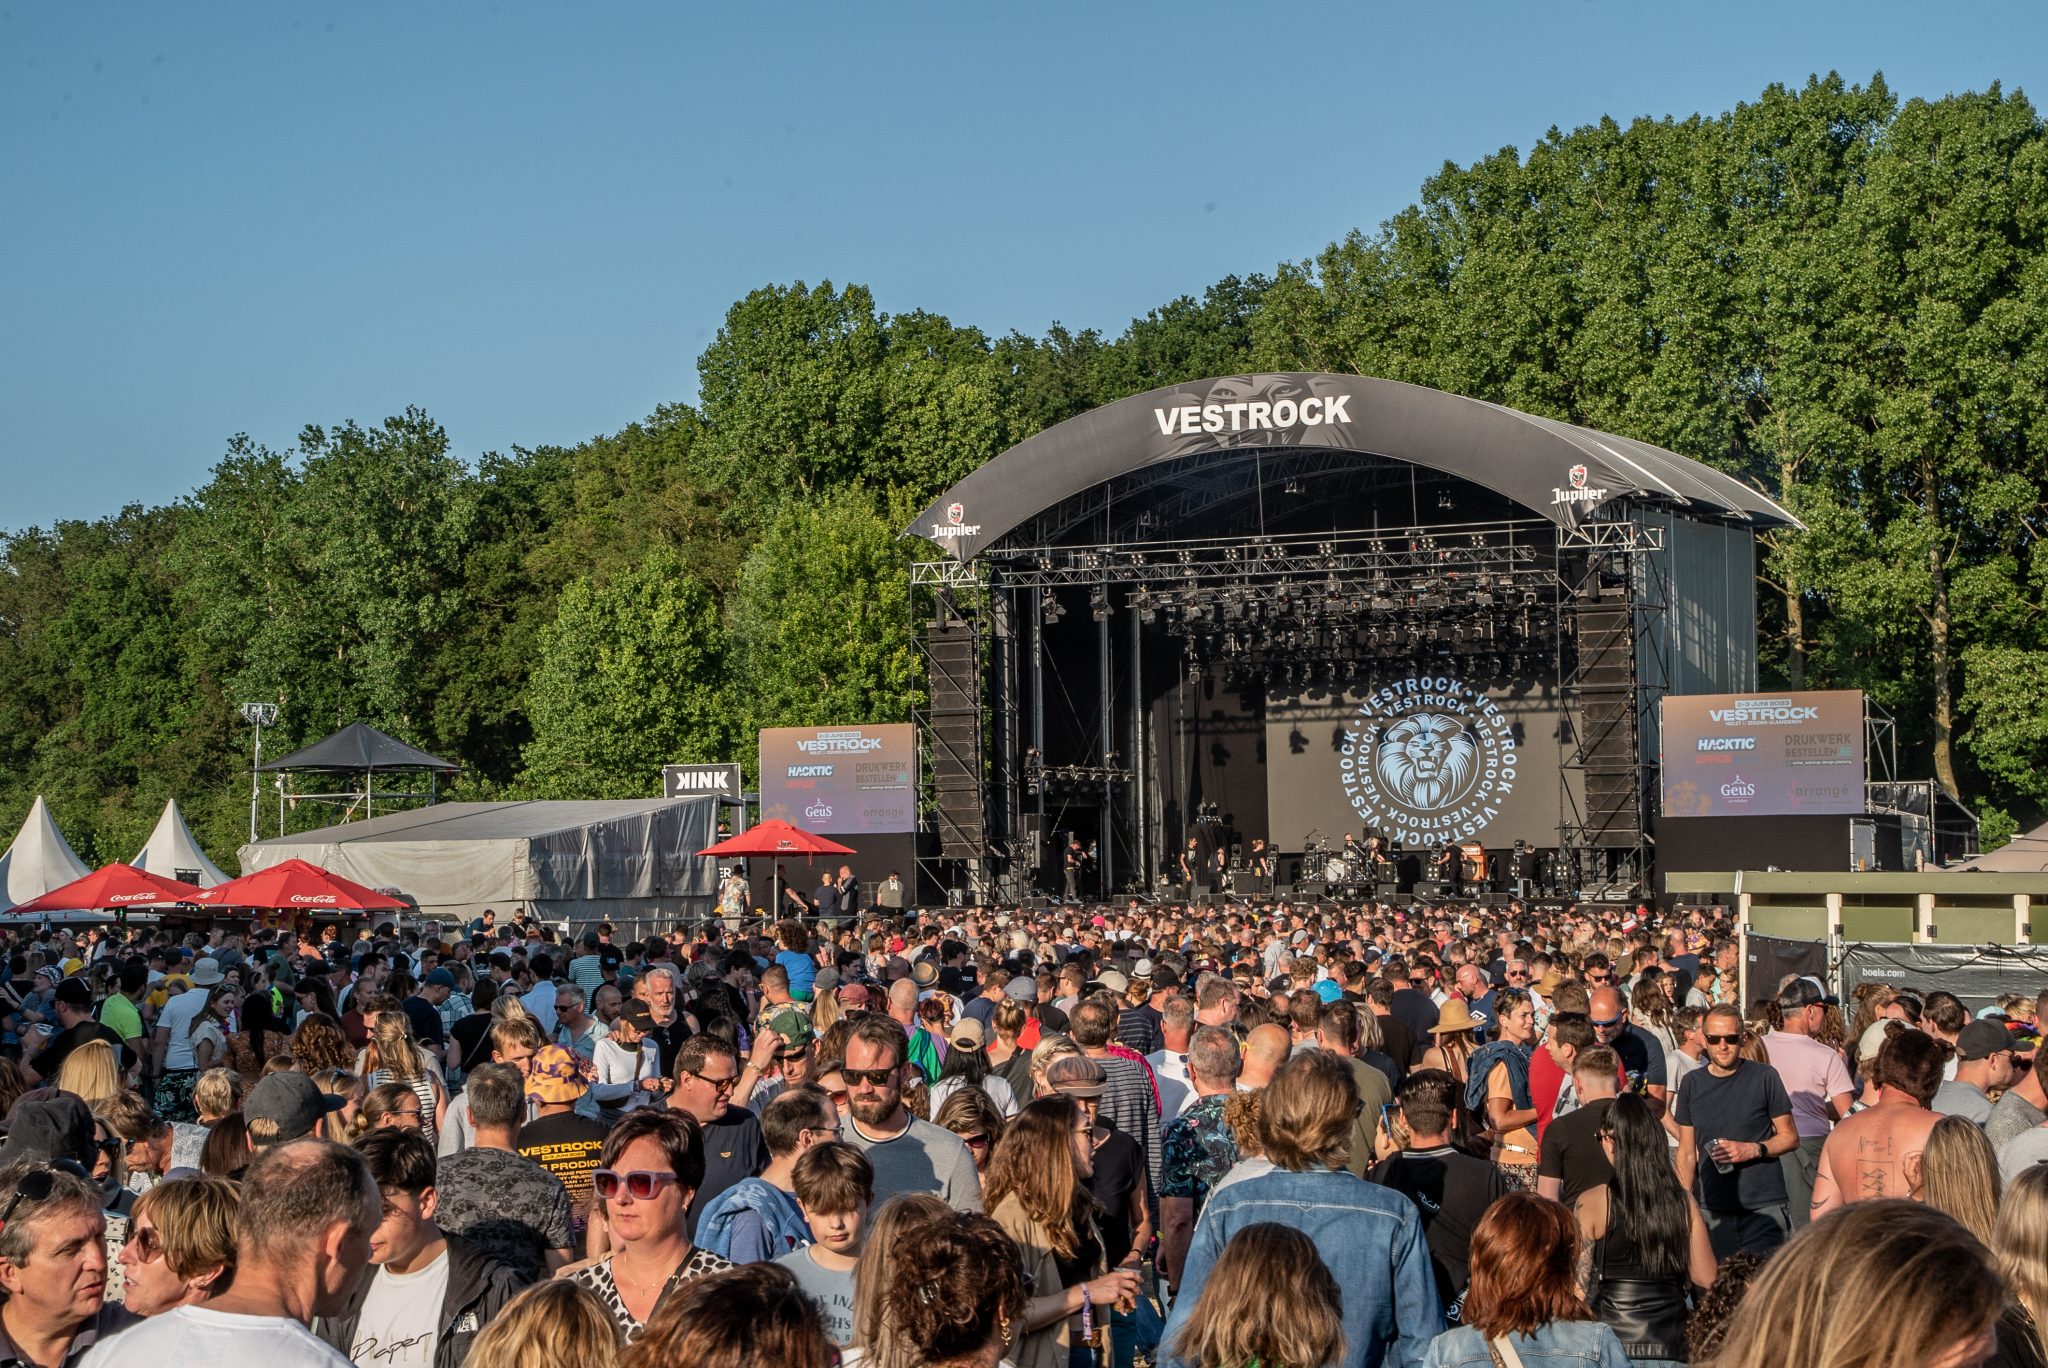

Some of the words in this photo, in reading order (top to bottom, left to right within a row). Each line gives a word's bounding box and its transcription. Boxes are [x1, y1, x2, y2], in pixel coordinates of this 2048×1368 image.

[1154, 395, 1352, 435] VESTROCK
[1550, 486, 1607, 505] Jupiler
[929, 523, 981, 540] Jupiler
[1358, 676, 1463, 717] VESTROCK
[1383, 694, 1470, 718] VESTROCK
[1709, 706, 1819, 722] VESTROCK
[797, 738, 882, 752] VESTROCK
[1474, 694, 1518, 795] VESTROCK
[1697, 738, 1756, 751] HACKTIC
[1784, 733, 1852, 746] DRUKWERK
[855, 761, 907, 773] DRUKWERK
[1358, 722, 1381, 805] VESTROCK
[1474, 718, 1499, 801] VESTROCK
[676, 771, 729, 790] KINK
[787, 765, 833, 777] HACKTIC
[1340, 730, 1381, 828] VESTROCK
[1386, 805, 1472, 829] VESTROCK
[1393, 805, 1499, 846] VESTROCK
[110, 892, 157, 902] Coca-Cola
[290, 894, 337, 903] Coca-Cola
[519, 1141, 603, 1157] VESTROCK
